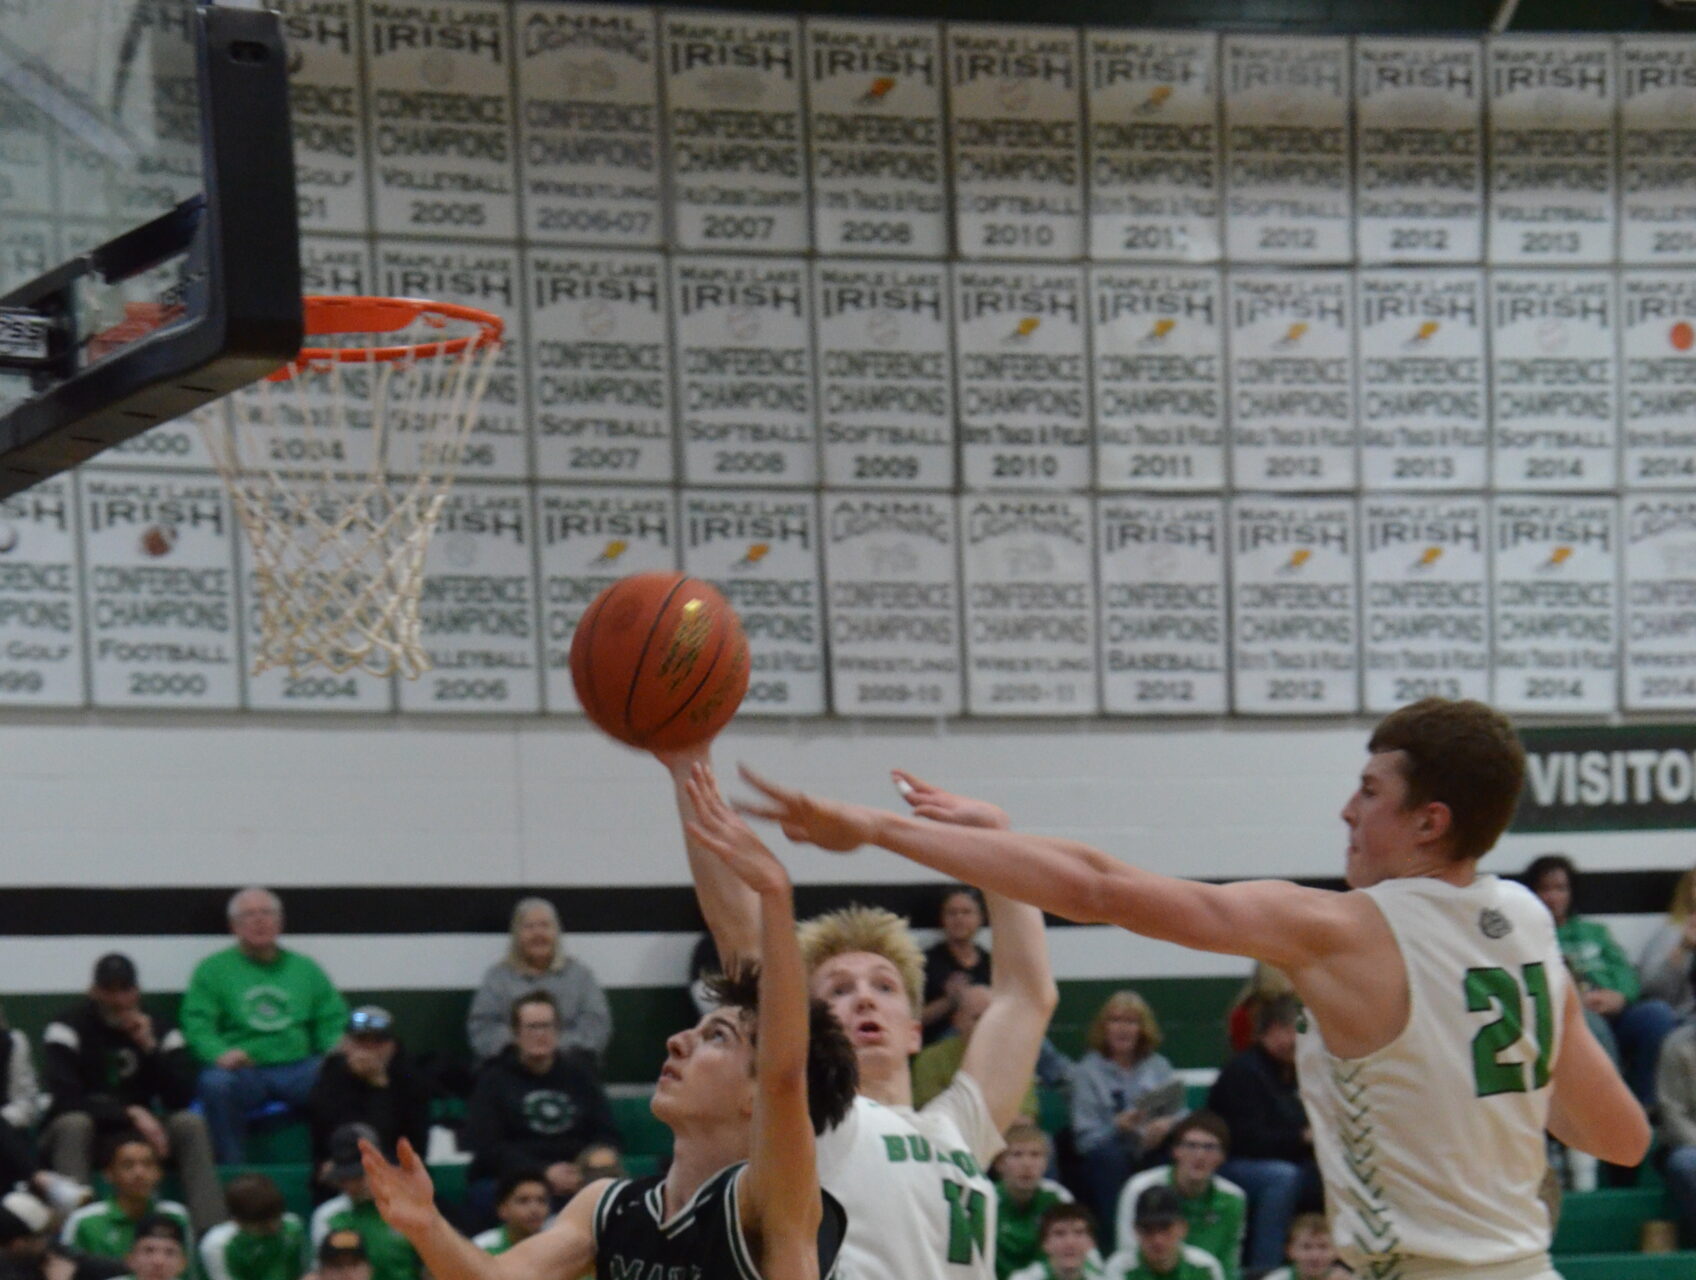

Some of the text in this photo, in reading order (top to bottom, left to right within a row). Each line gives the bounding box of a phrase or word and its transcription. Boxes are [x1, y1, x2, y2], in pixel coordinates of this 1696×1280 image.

[536, 276, 659, 314] IRISH
[682, 284, 803, 319] IRISH
[823, 286, 943, 323] IRISH
[962, 289, 1080, 327] IRISH
[1098, 291, 1215, 327] IRISH
[1364, 296, 1477, 329] IRISH
[1498, 296, 1609, 330] IRISH
[90, 500, 224, 537] IRISH
[545, 514, 670, 548] IRISH
[690, 516, 810, 551] IRISH
[1369, 520, 1481, 552] IRISH
[1105, 522, 1218, 555] IRISH
[1239, 523, 1348, 555] IRISH
[1501, 520, 1611, 553] IRISH
[1526, 749, 1696, 806] VISITO
[1464, 960, 1553, 1096] 21
